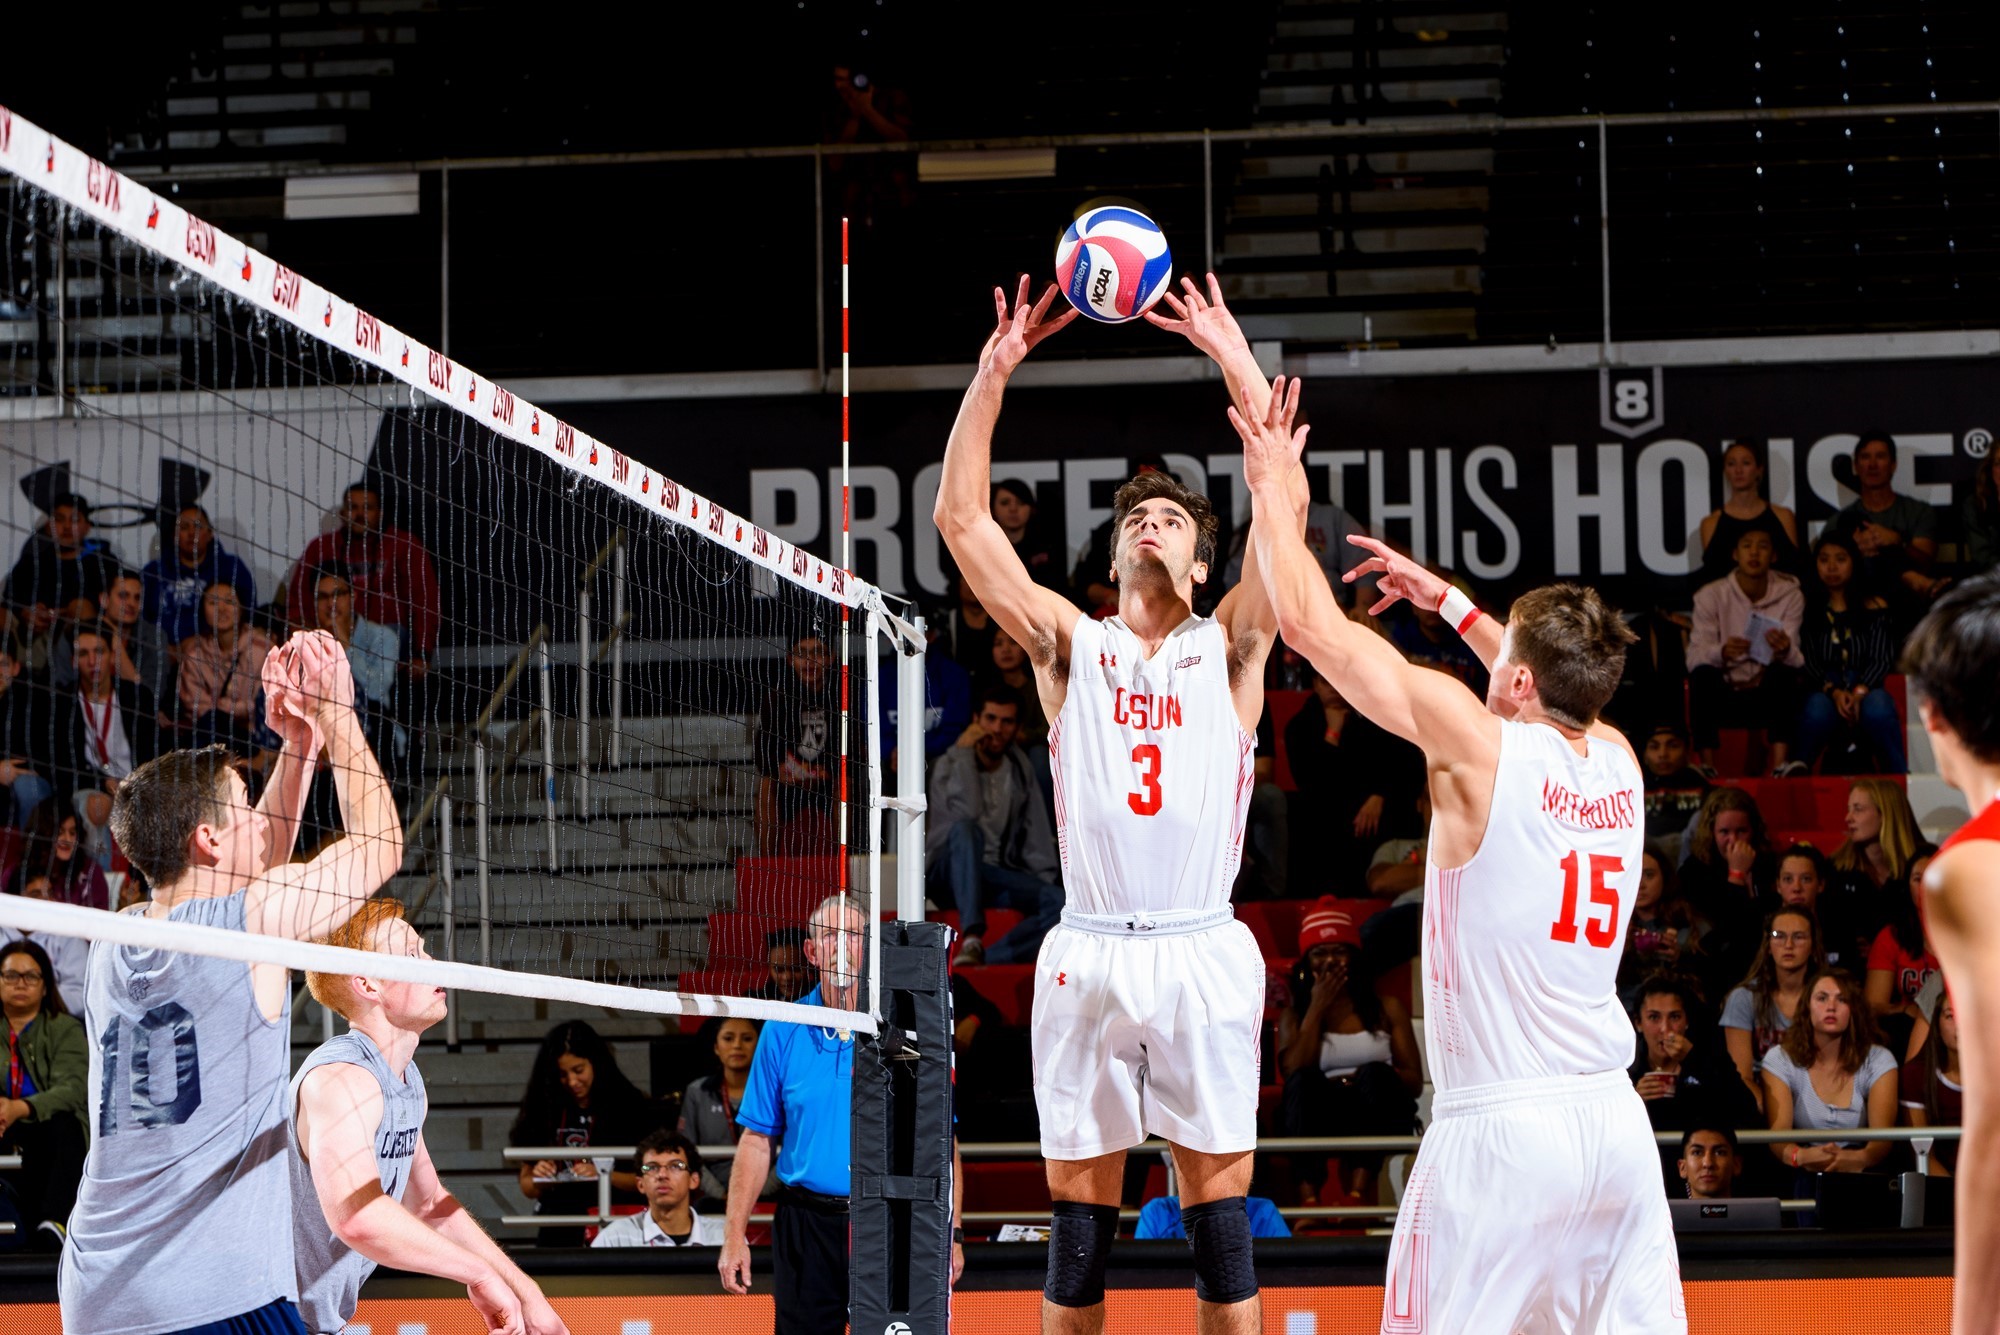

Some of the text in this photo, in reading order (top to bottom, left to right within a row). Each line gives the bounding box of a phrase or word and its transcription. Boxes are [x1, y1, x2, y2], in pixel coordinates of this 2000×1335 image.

[1073, 259, 1089, 297] molten
[1091, 268, 1113, 307] NCAA
[1616, 379, 1648, 419] 8
[751, 453, 1252, 598] PROET
[1307, 445, 1521, 580] THIS
[1113, 686, 1183, 731] CSUN
[1127, 743, 1162, 817] 3
[1550, 849, 1626, 949] 15
[99, 1001, 202, 1138] 10
